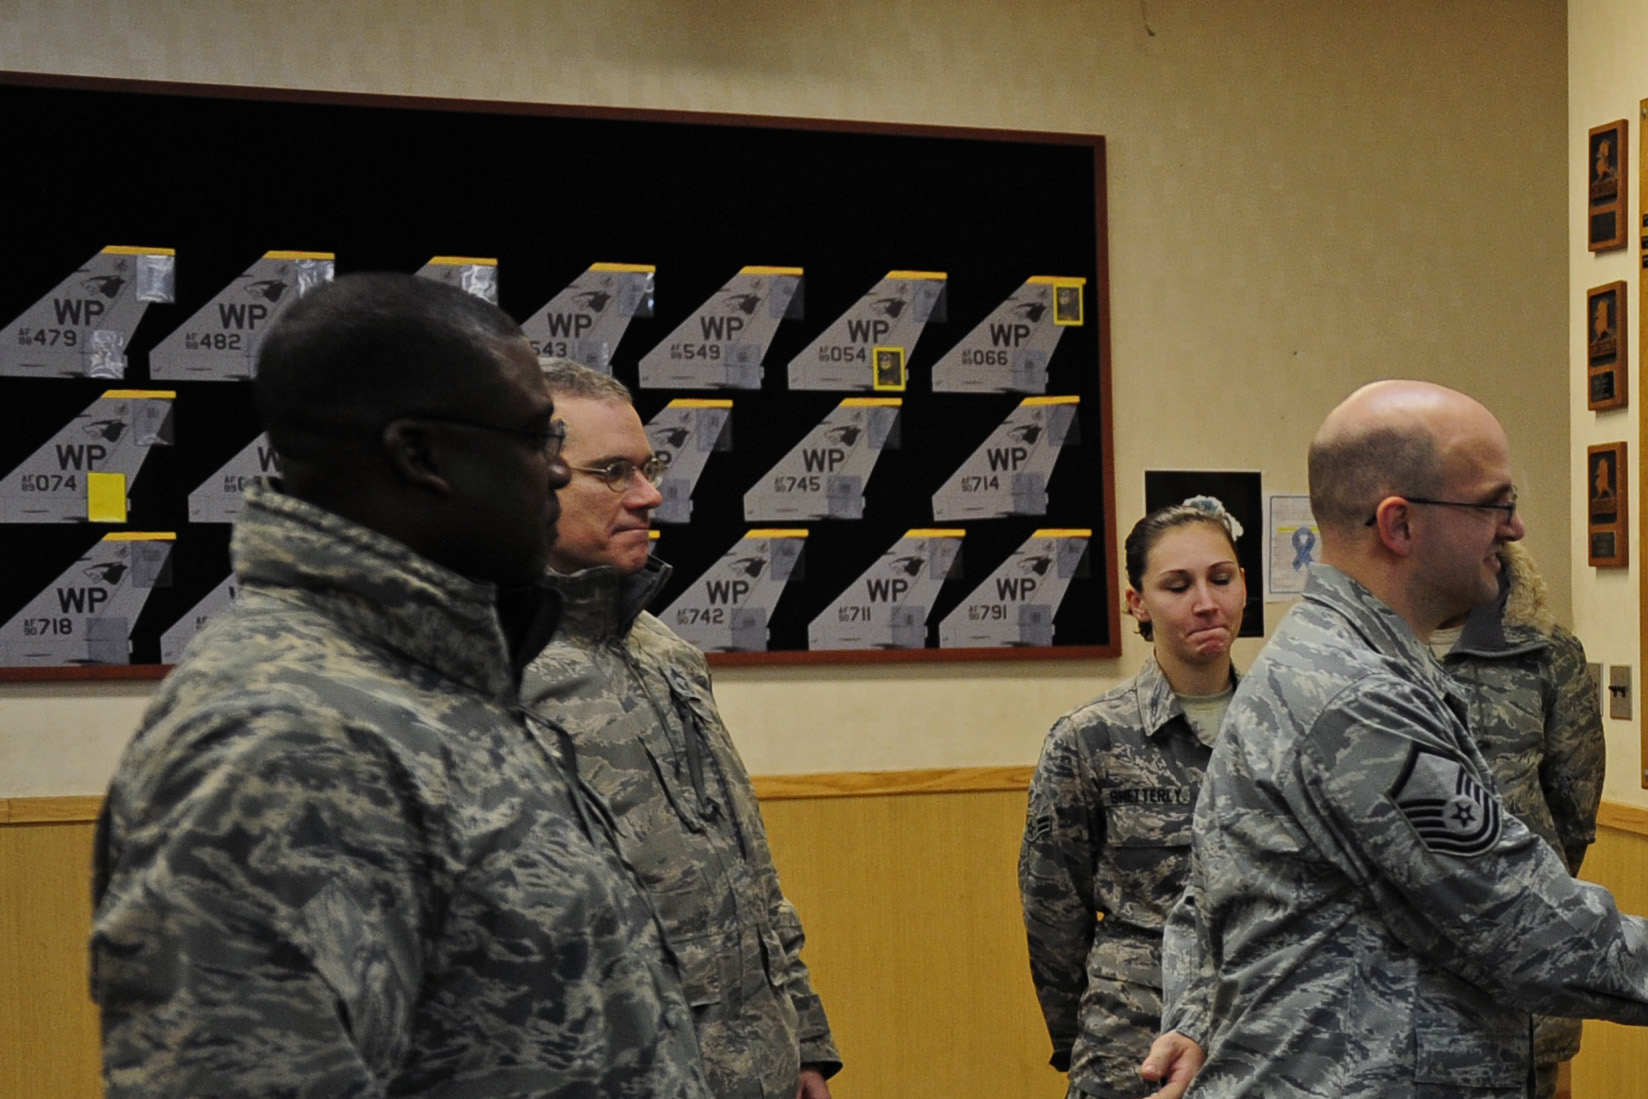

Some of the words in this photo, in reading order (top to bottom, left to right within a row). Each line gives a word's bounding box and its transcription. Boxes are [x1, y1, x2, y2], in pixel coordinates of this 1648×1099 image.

[53, 299, 105, 326] WP
[219, 303, 268, 330] WP
[547, 313, 592, 338] WP
[700, 316, 744, 341] WP
[847, 320, 889, 343] WP
[990, 323, 1030, 347] WP
[33, 329, 77, 347] 479
[200, 333, 241, 350] 482
[683, 344, 720, 360] 549
[830, 346, 866, 362] 054
[973, 350, 1008, 365] 066
[56, 444, 107, 471] WP
[803, 448, 845, 472] WP
[987, 447, 1027, 471] WP
[36, 474, 77, 491] 074
[786, 476, 820, 492] 745
[972, 476, 1000, 491] 714
[57, 587, 108, 614] WP
[706, 580, 749, 605] WP
[866, 579, 908, 602] WP
[996, 578, 1036, 601] WP
[689, 608, 724, 625] 742
[850, 606, 871, 621] 711
[980, 604, 1007, 620] 791
[38, 618, 72, 635] 718
